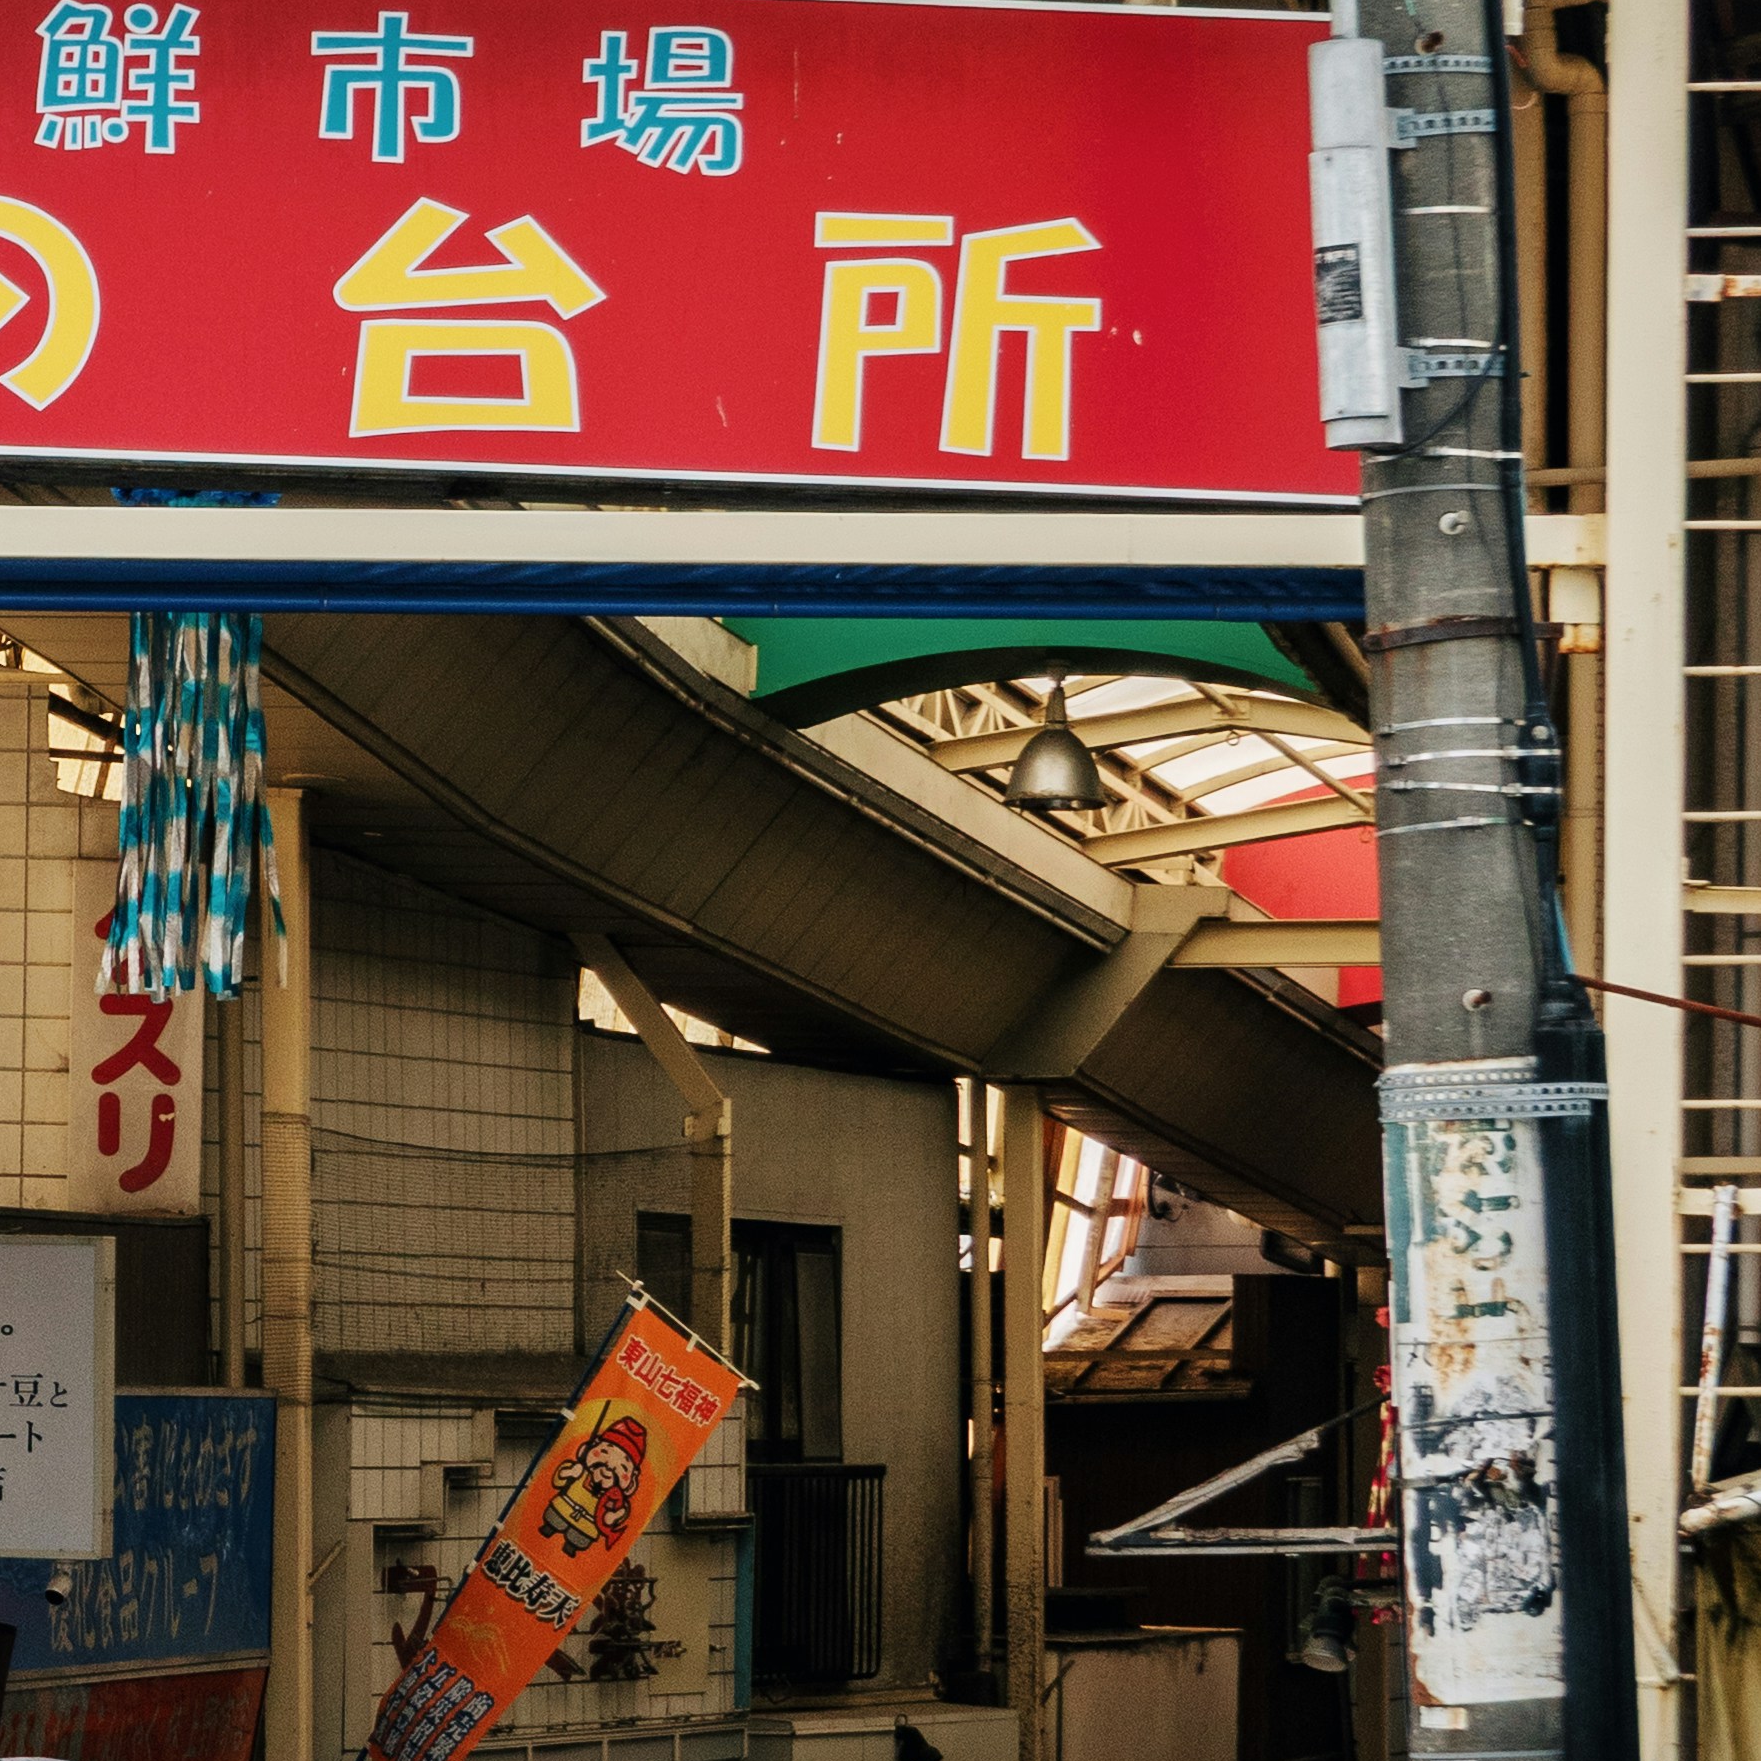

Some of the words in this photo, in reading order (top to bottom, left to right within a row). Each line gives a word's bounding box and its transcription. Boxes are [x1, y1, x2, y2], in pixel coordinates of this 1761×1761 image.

[616, 1334, 721, 1428] 東山七福神
[482, 1537, 581, 1629] 恵比寿天
